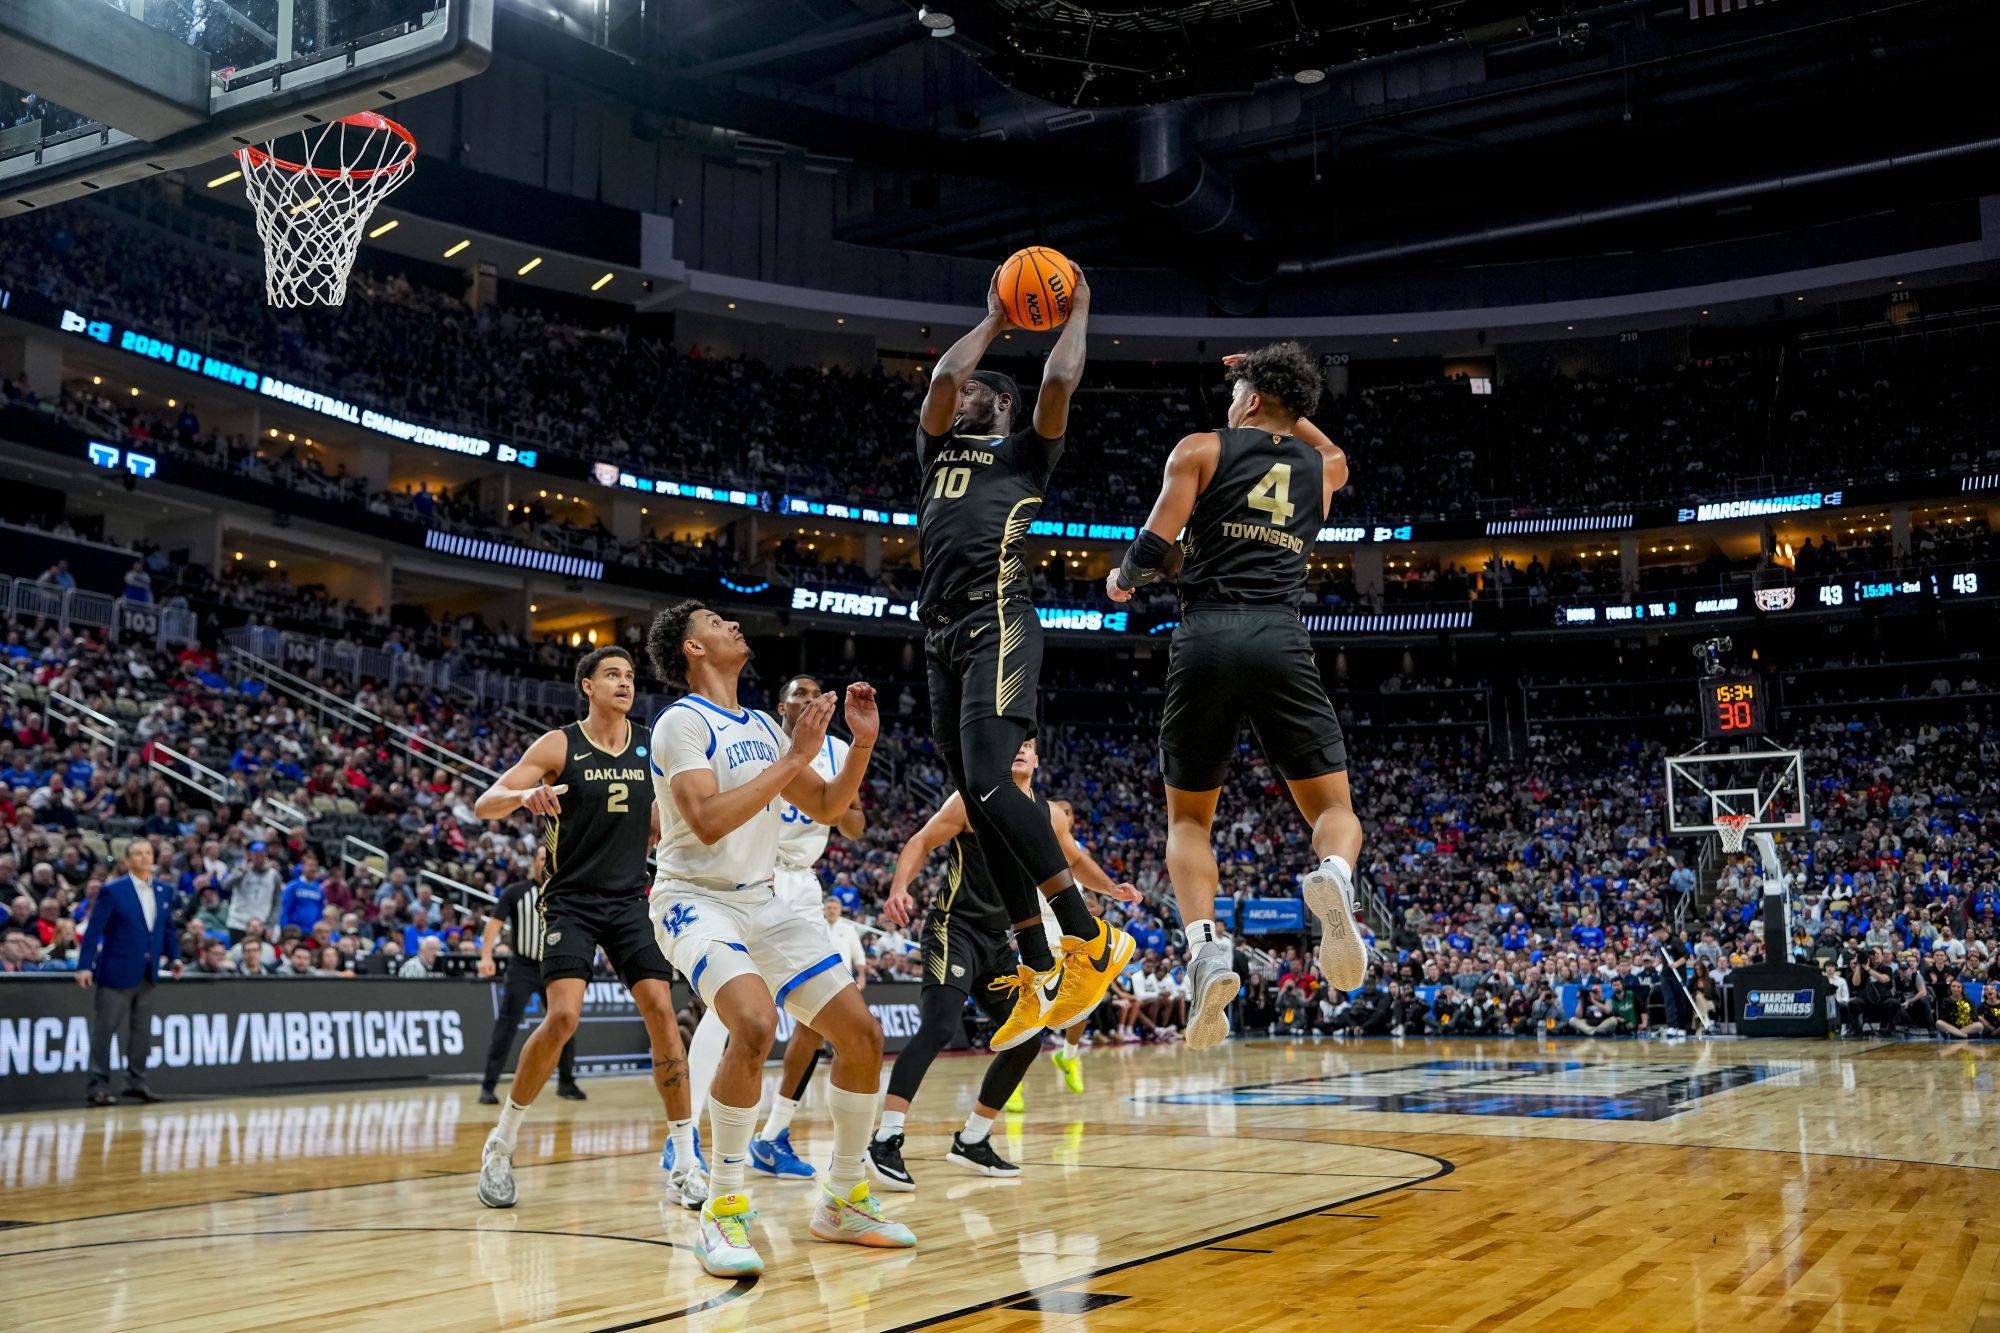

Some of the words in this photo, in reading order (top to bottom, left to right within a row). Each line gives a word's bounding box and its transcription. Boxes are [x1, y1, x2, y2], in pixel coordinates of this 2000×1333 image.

[1891, 291, 1910, 303] 211
[1025, 292, 1044, 326] NCAA
[1325, 354, 1349, 367] 209
[120, 330, 175, 363] 2024
[203, 357, 258, 390] MEN'S
[260, 376, 360, 424] BASKETBALL
[361, 409, 490, 456] CHAMPIONSHIP
[935, 450, 995, 465] KLAND
[934, 467, 972, 499] 10
[1247, 462, 1295, 526] 4
[1027, 520, 1064, 536] 024
[1088, 524, 1136, 540] MEN'S
[1221, 521, 1304, 554] TOWNSEND
[819, 590, 889, 618] FIRST
[1606, 606, 1632, 619] FOULS
[1635, 605, 1644, 618] 2
[1649, 603, 1665, 617] TOL
[1669, 602, 1677, 615] 3
[1695, 598, 1738, 613] OAKLAND
[1820, 585, 1843, 606] 43
[1862, 583, 1894, 599] 15:34
[1902, 581, 1921, 594] 2nd
[1952, 573, 1978, 594] 43
[124, 610, 158, 634] 103
[1035, 607, 1103, 630] UNDS
[1828, 624, 1843, 634] 107
[288, 643, 315, 661] 104
[1717, 684, 1753, 702] 15:34
[1718, 702, 1751, 730] 30
[584, 768, 645, 781] OAKLAND
[607, 782, 629, 813] 2
[780, 805, 814, 824] 3
[1759, 992, 1795, 1004] MARCH
[1764, 1003, 1812, 1014] MADNESS
